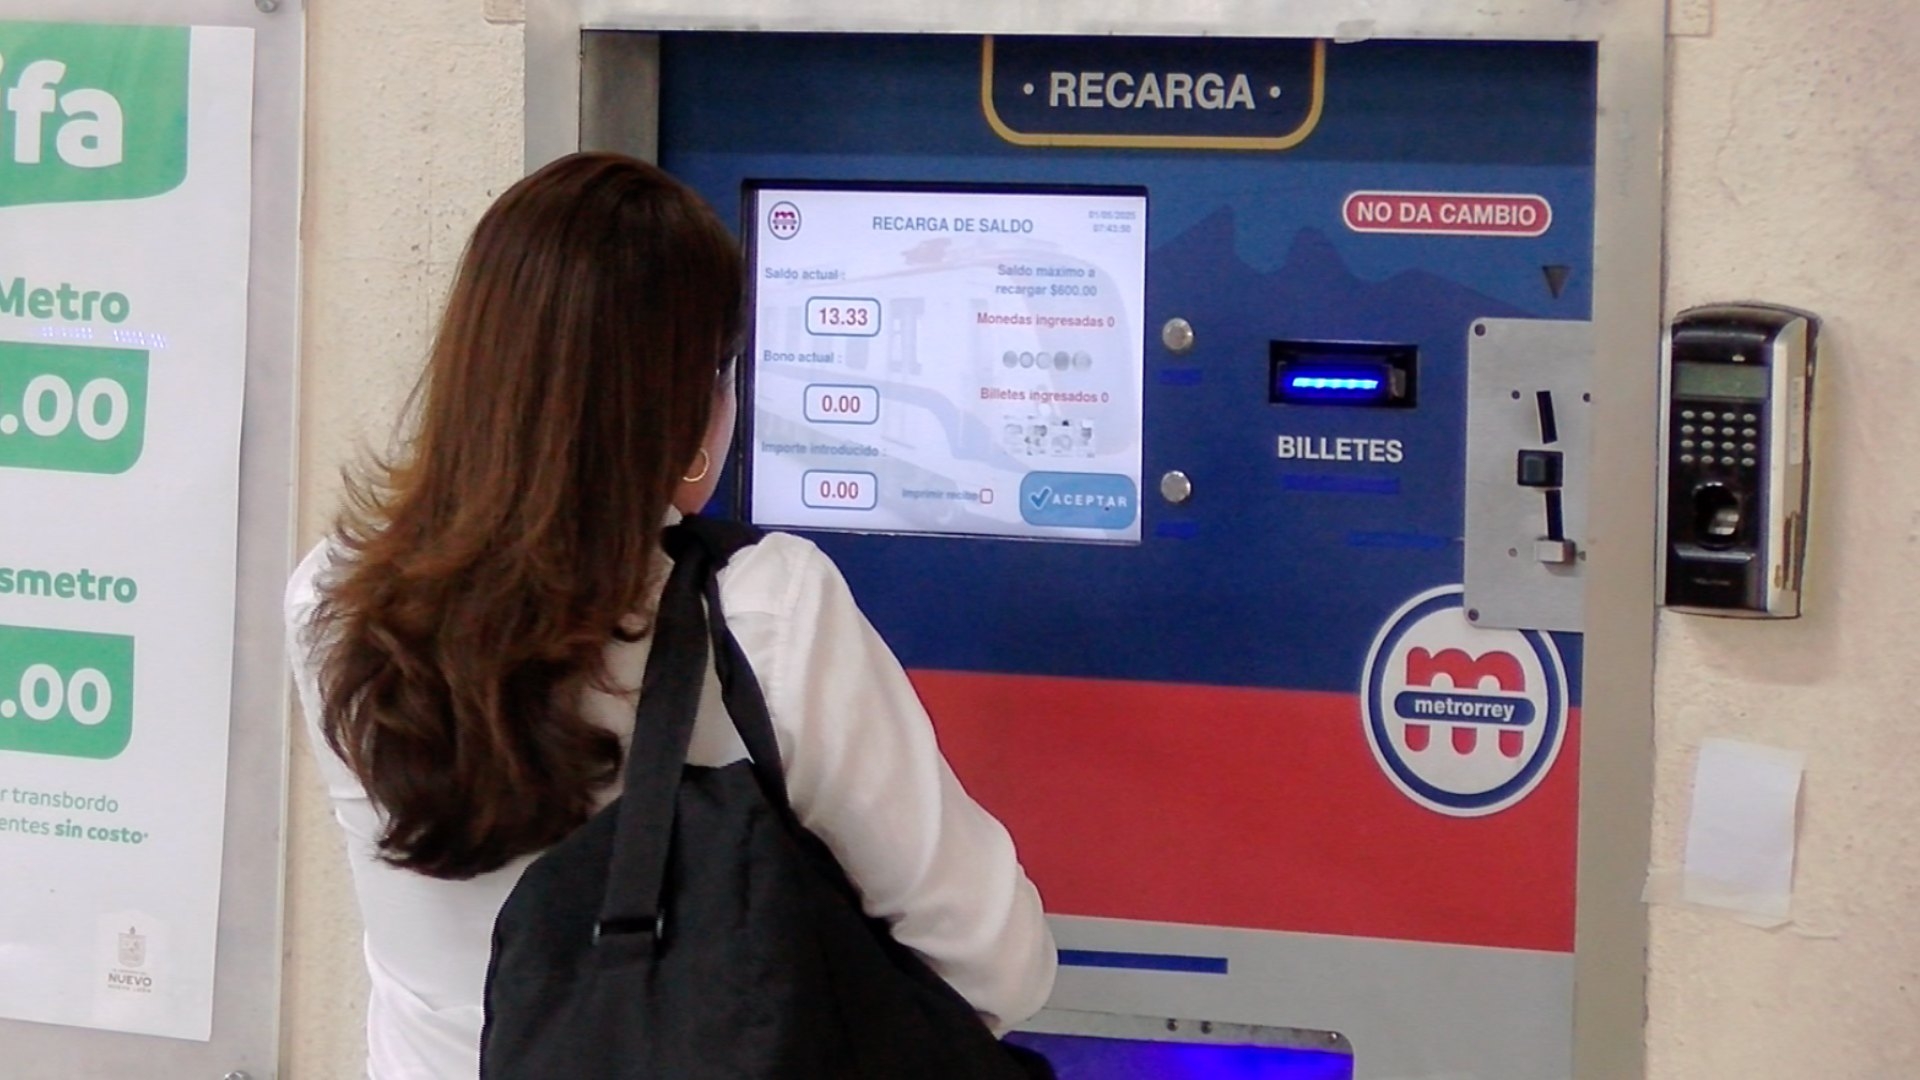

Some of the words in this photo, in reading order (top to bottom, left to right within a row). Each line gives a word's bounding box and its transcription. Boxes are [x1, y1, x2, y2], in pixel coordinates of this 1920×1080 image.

[1050, 72, 1255, 109] RECARGA
[0, 53, 123, 168] fa
[872, 216, 949, 232] RECARGA
[954, 218, 975, 232] DE
[979, 218, 1033, 233] SALDO
[1357, 204, 1392, 223] NO
[1400, 204, 1432, 224] DA
[1439, 204, 1536, 227] CAMBIO
[765, 267, 798, 279] Saldo
[802, 268, 838, 280] actual
[997, 264, 1033, 276] Saldo
[1088, 269, 1096, 278] a
[996, 284, 1046, 297] recargar
[1050, 284, 1097, 296] $600.00
[0, 277, 130, 323] Metro
[819, 307, 868, 326] 13.33
[977, 312, 1032, 325] Monedas
[1035, 314, 1104, 328] ingresadas
[1107, 316, 1115, 327] 0
[763, 350, 795, 362] Bono
[798, 351, 834, 363] actual
[822, 395, 860, 413] 0.00
[980, 387, 1026, 400] Billetes
[1029, 389, 1098, 403] ingresados
[1101, 392, 1109, 402] 0
[761, 442, 807, 455] Importe
[810, 443, 879, 457] introducido
[1277, 435, 1404, 463] BILLETES
[820, 480, 859, 499] 0.00
[1052, 493, 1128, 508] ACEPTAR
[0, 568, 137, 603] smetro
[1414, 698, 1515, 722] metrorrey
[13, 788, 118, 813] transbordo
[55, 819, 83, 838] sin
[108, 973, 152, 987] NUEVO
